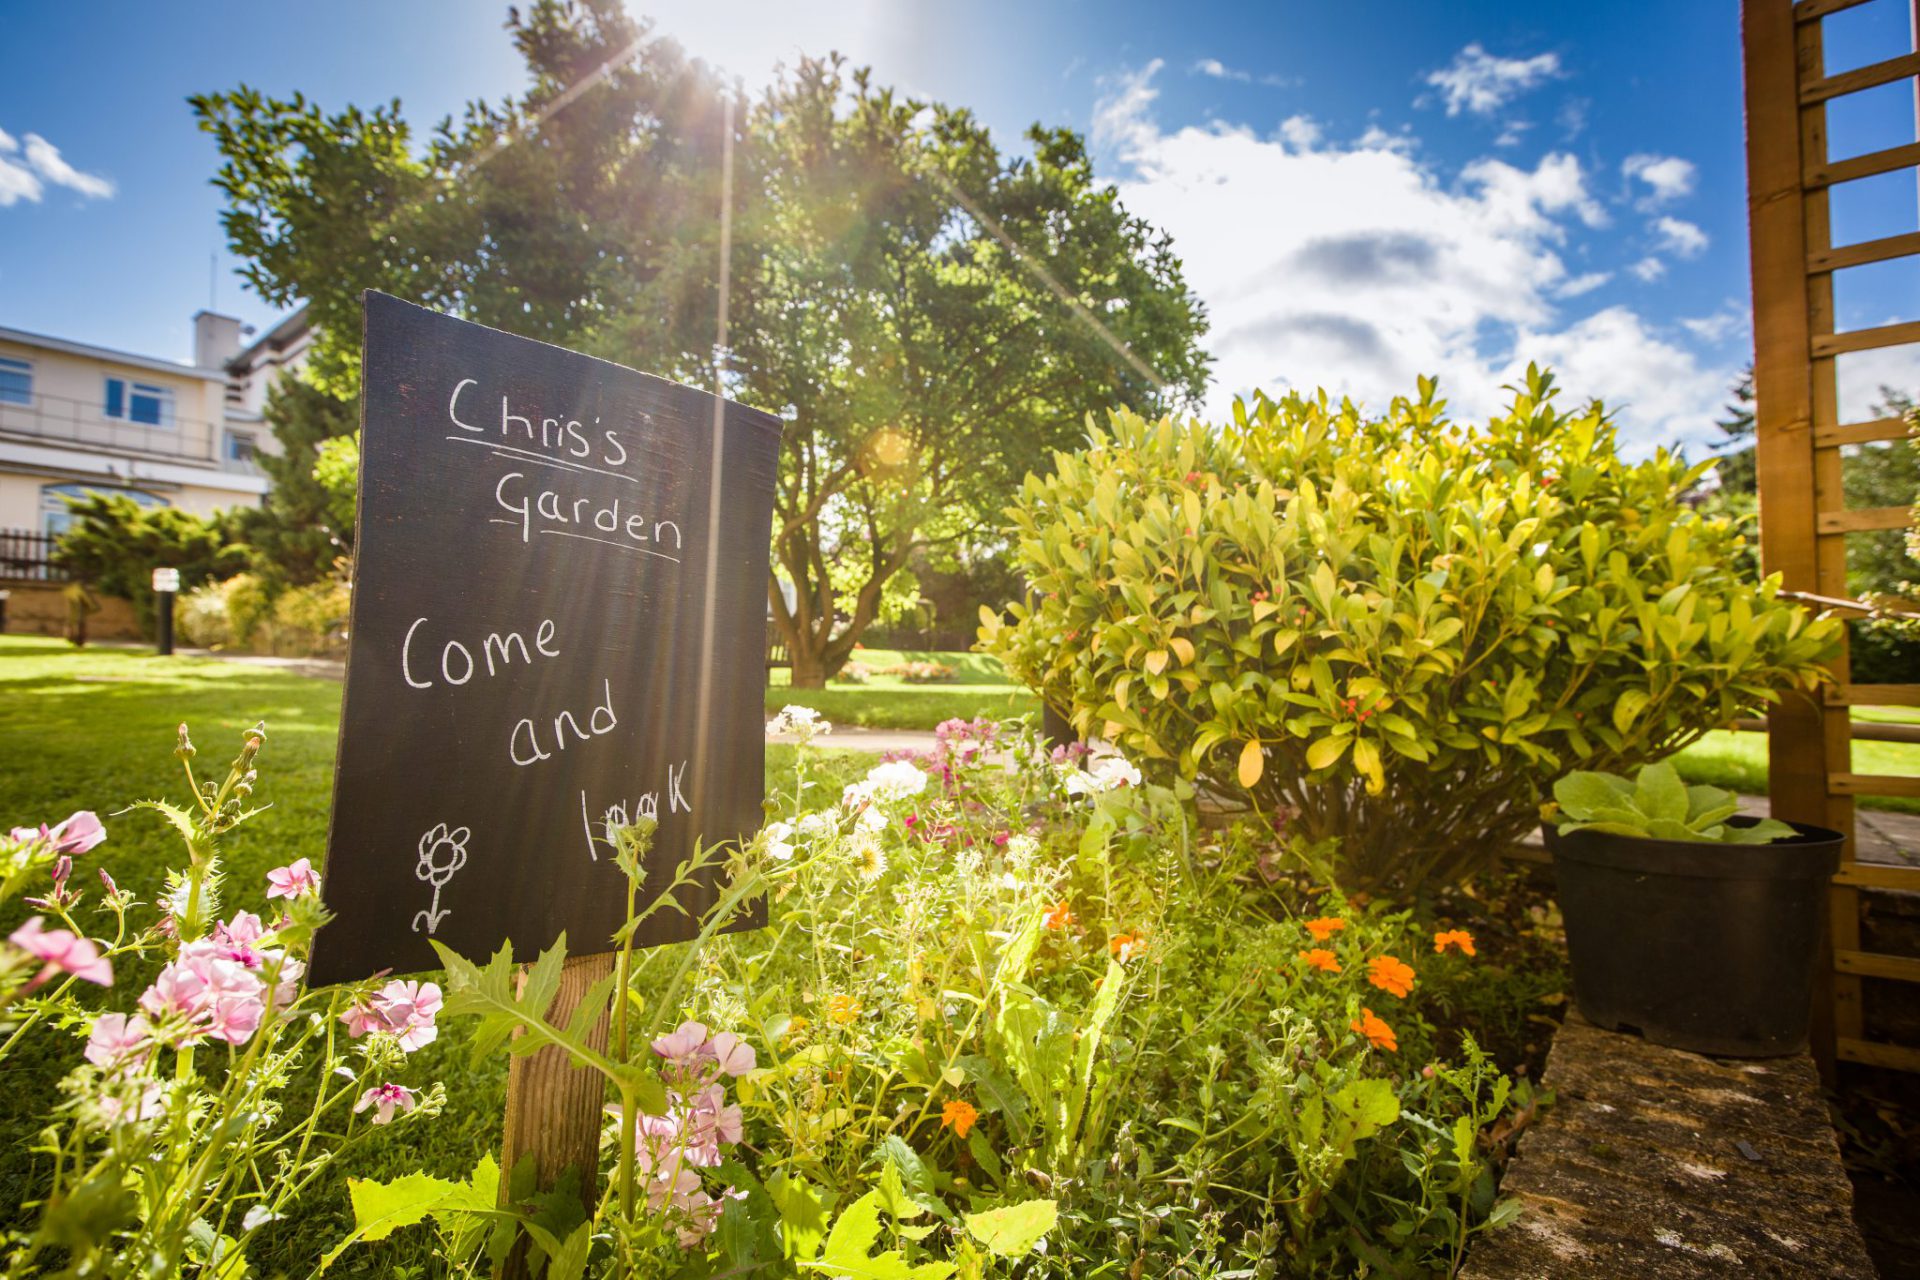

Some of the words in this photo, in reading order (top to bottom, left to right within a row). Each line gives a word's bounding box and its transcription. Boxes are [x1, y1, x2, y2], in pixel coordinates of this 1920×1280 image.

[449, 378, 627, 466] Chris's
[495, 472, 681, 550] Garden
[402, 617, 560, 689] Come
[509, 678, 618, 766] and
